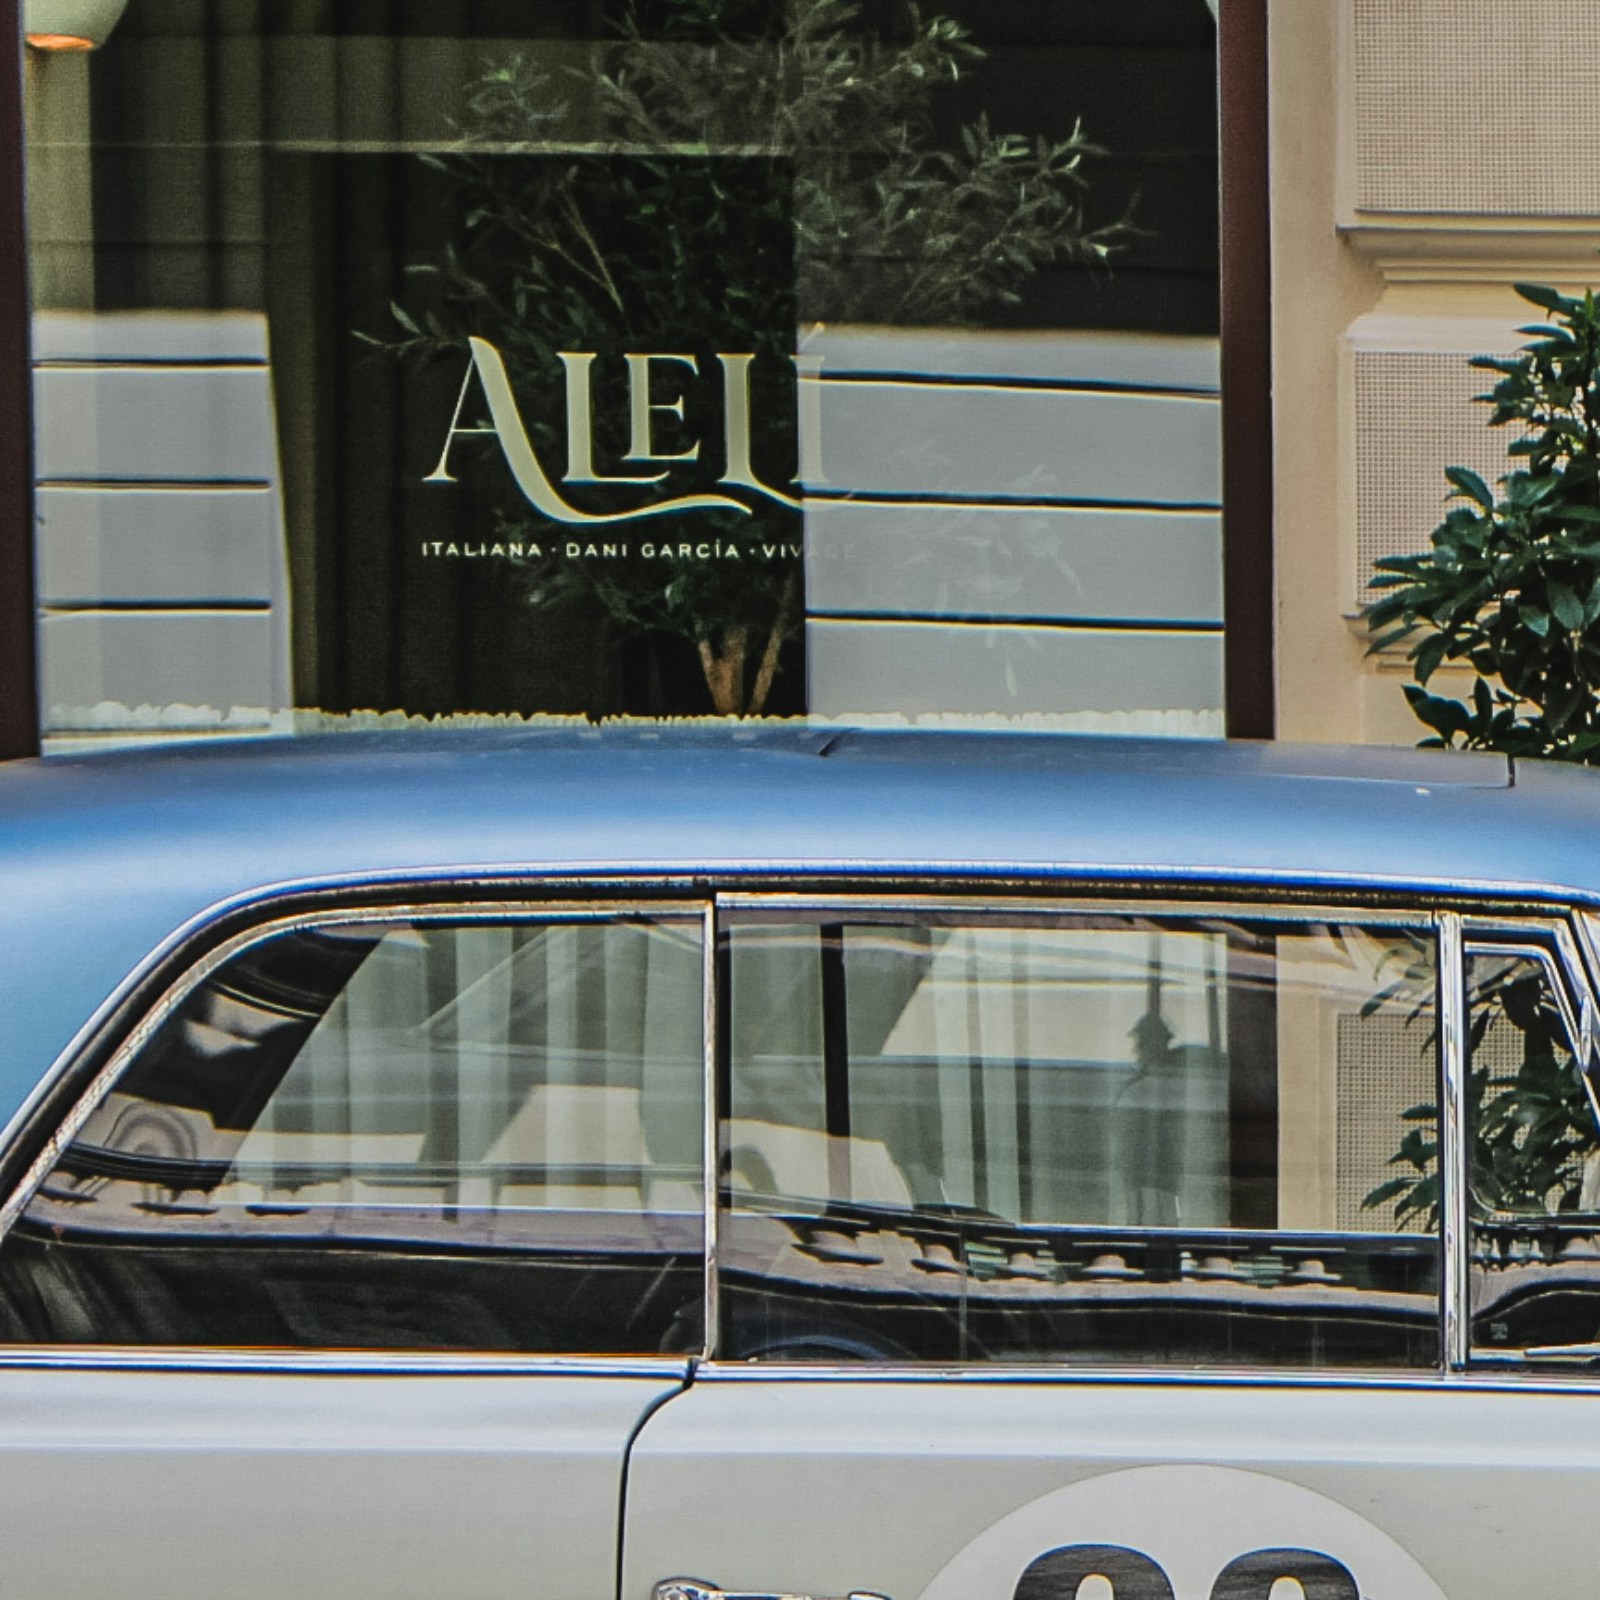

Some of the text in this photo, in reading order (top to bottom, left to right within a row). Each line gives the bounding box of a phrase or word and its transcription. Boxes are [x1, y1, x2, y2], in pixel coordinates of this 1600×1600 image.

[421, 541, 542, 558] ITALIANA
[566, 542, 628, 558] DANI
[641, 538, 740, 559] GARCÍA
